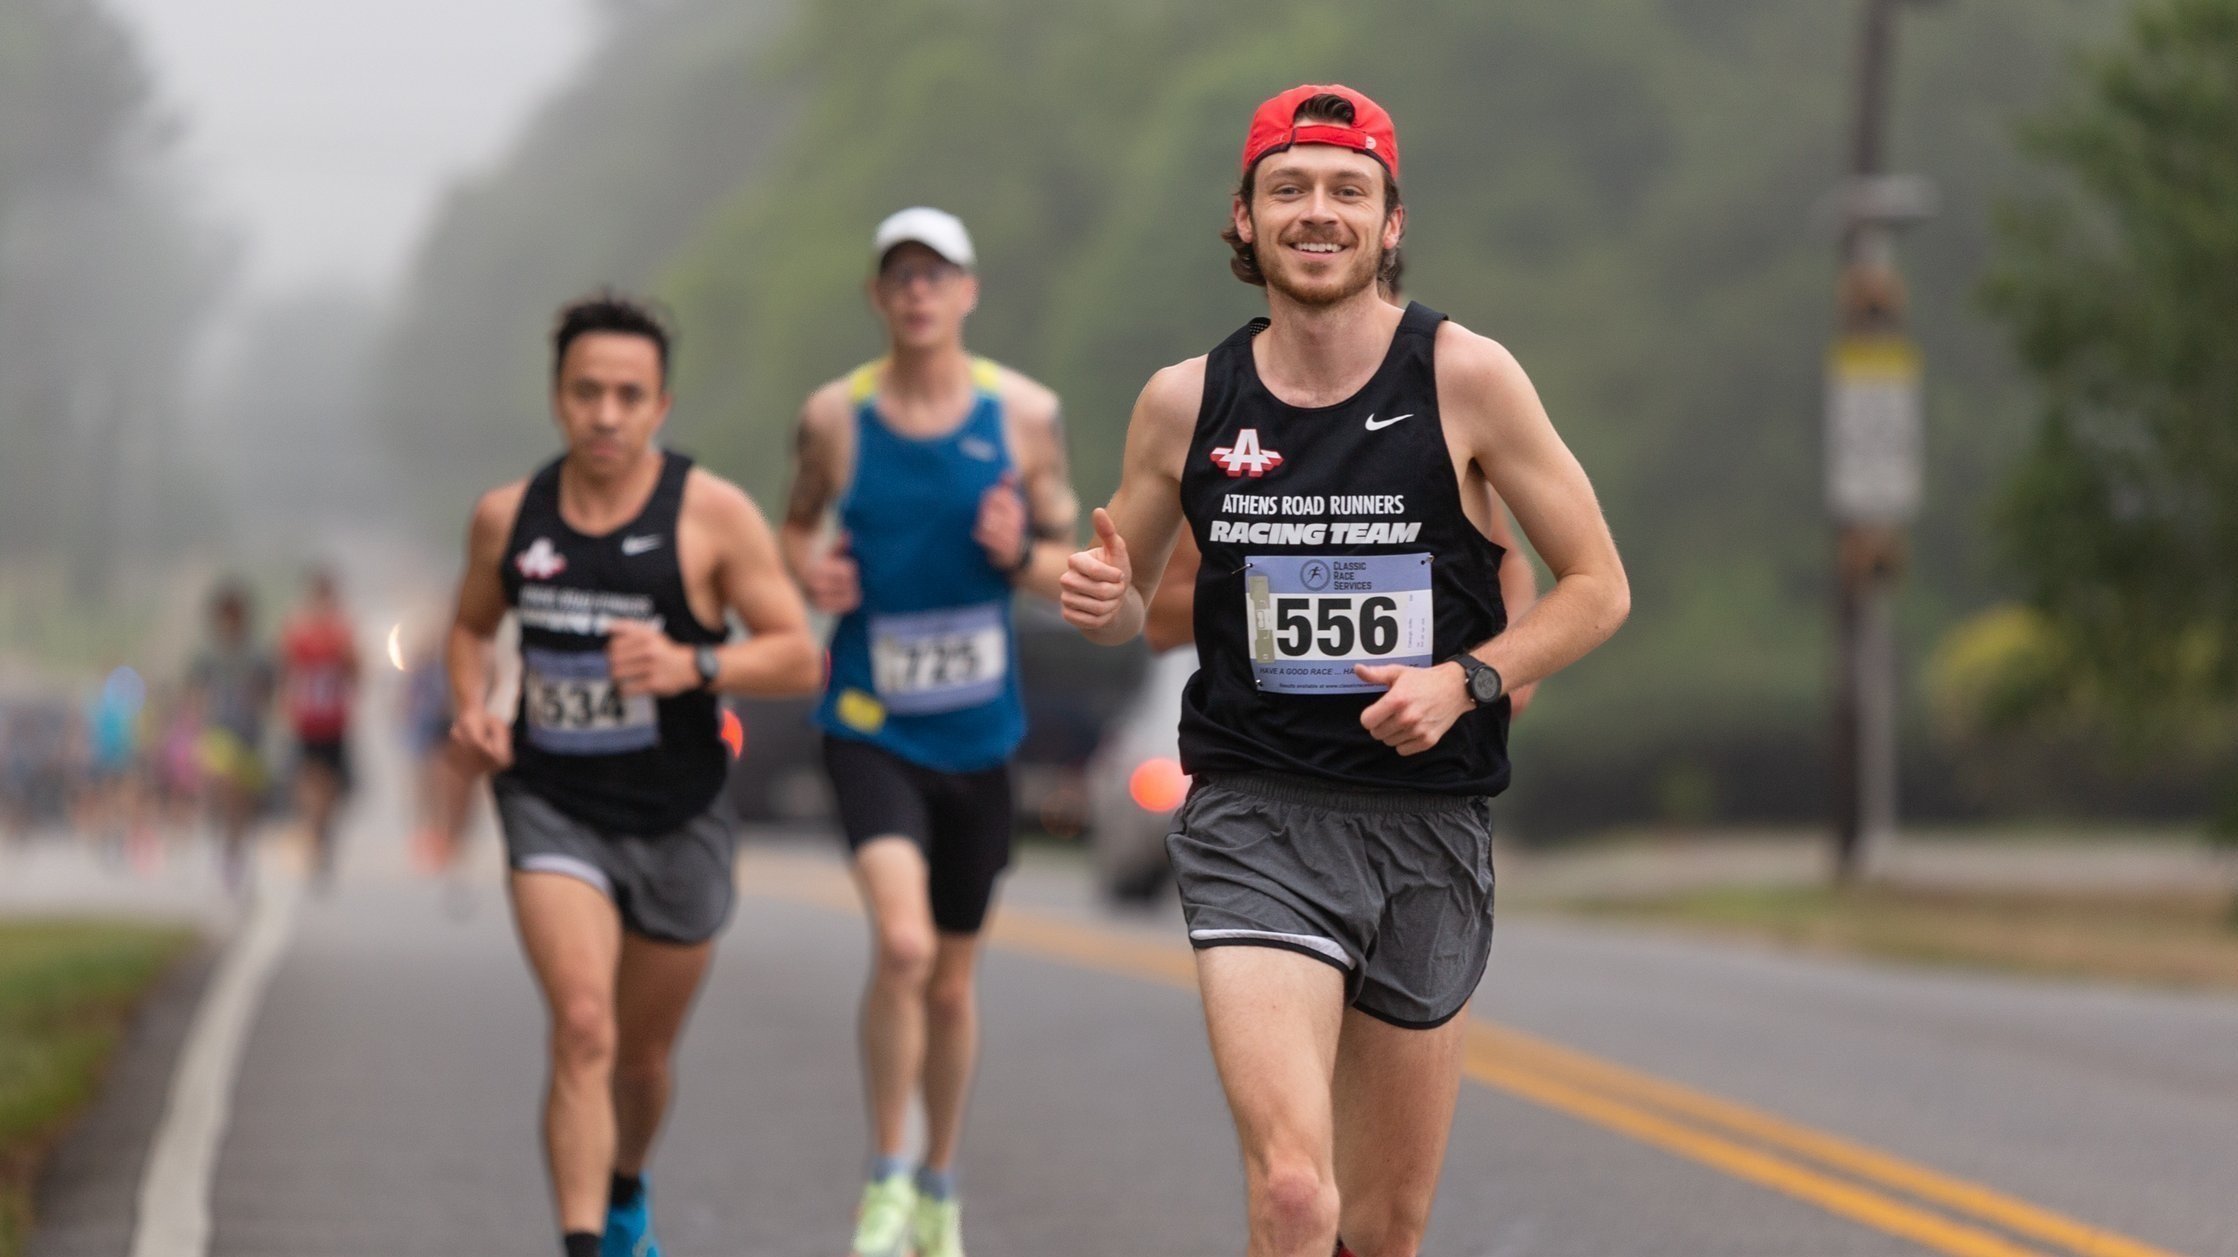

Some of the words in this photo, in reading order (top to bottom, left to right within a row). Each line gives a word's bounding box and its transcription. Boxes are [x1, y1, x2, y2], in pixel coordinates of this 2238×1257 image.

[1222, 494, 1278, 515] ATHENS
[1281, 496, 1325, 515] ROAD
[1330, 495, 1405, 515] RUNNERS
[1209, 520, 1328, 545] RACING
[1329, 522, 1422, 544] TEAM
[1333, 561, 1366, 571] CLASSIC
[1333, 571, 1355, 580] RACE
[1333, 581, 1372, 590] SERVICES
[1277, 596, 1399, 656] 556
[900, 637, 979, 688] 725
[1259, 667, 1278, 675] HAVE
[1310, 667, 1333, 675] RACE
[543, 685, 626, 728] 534
